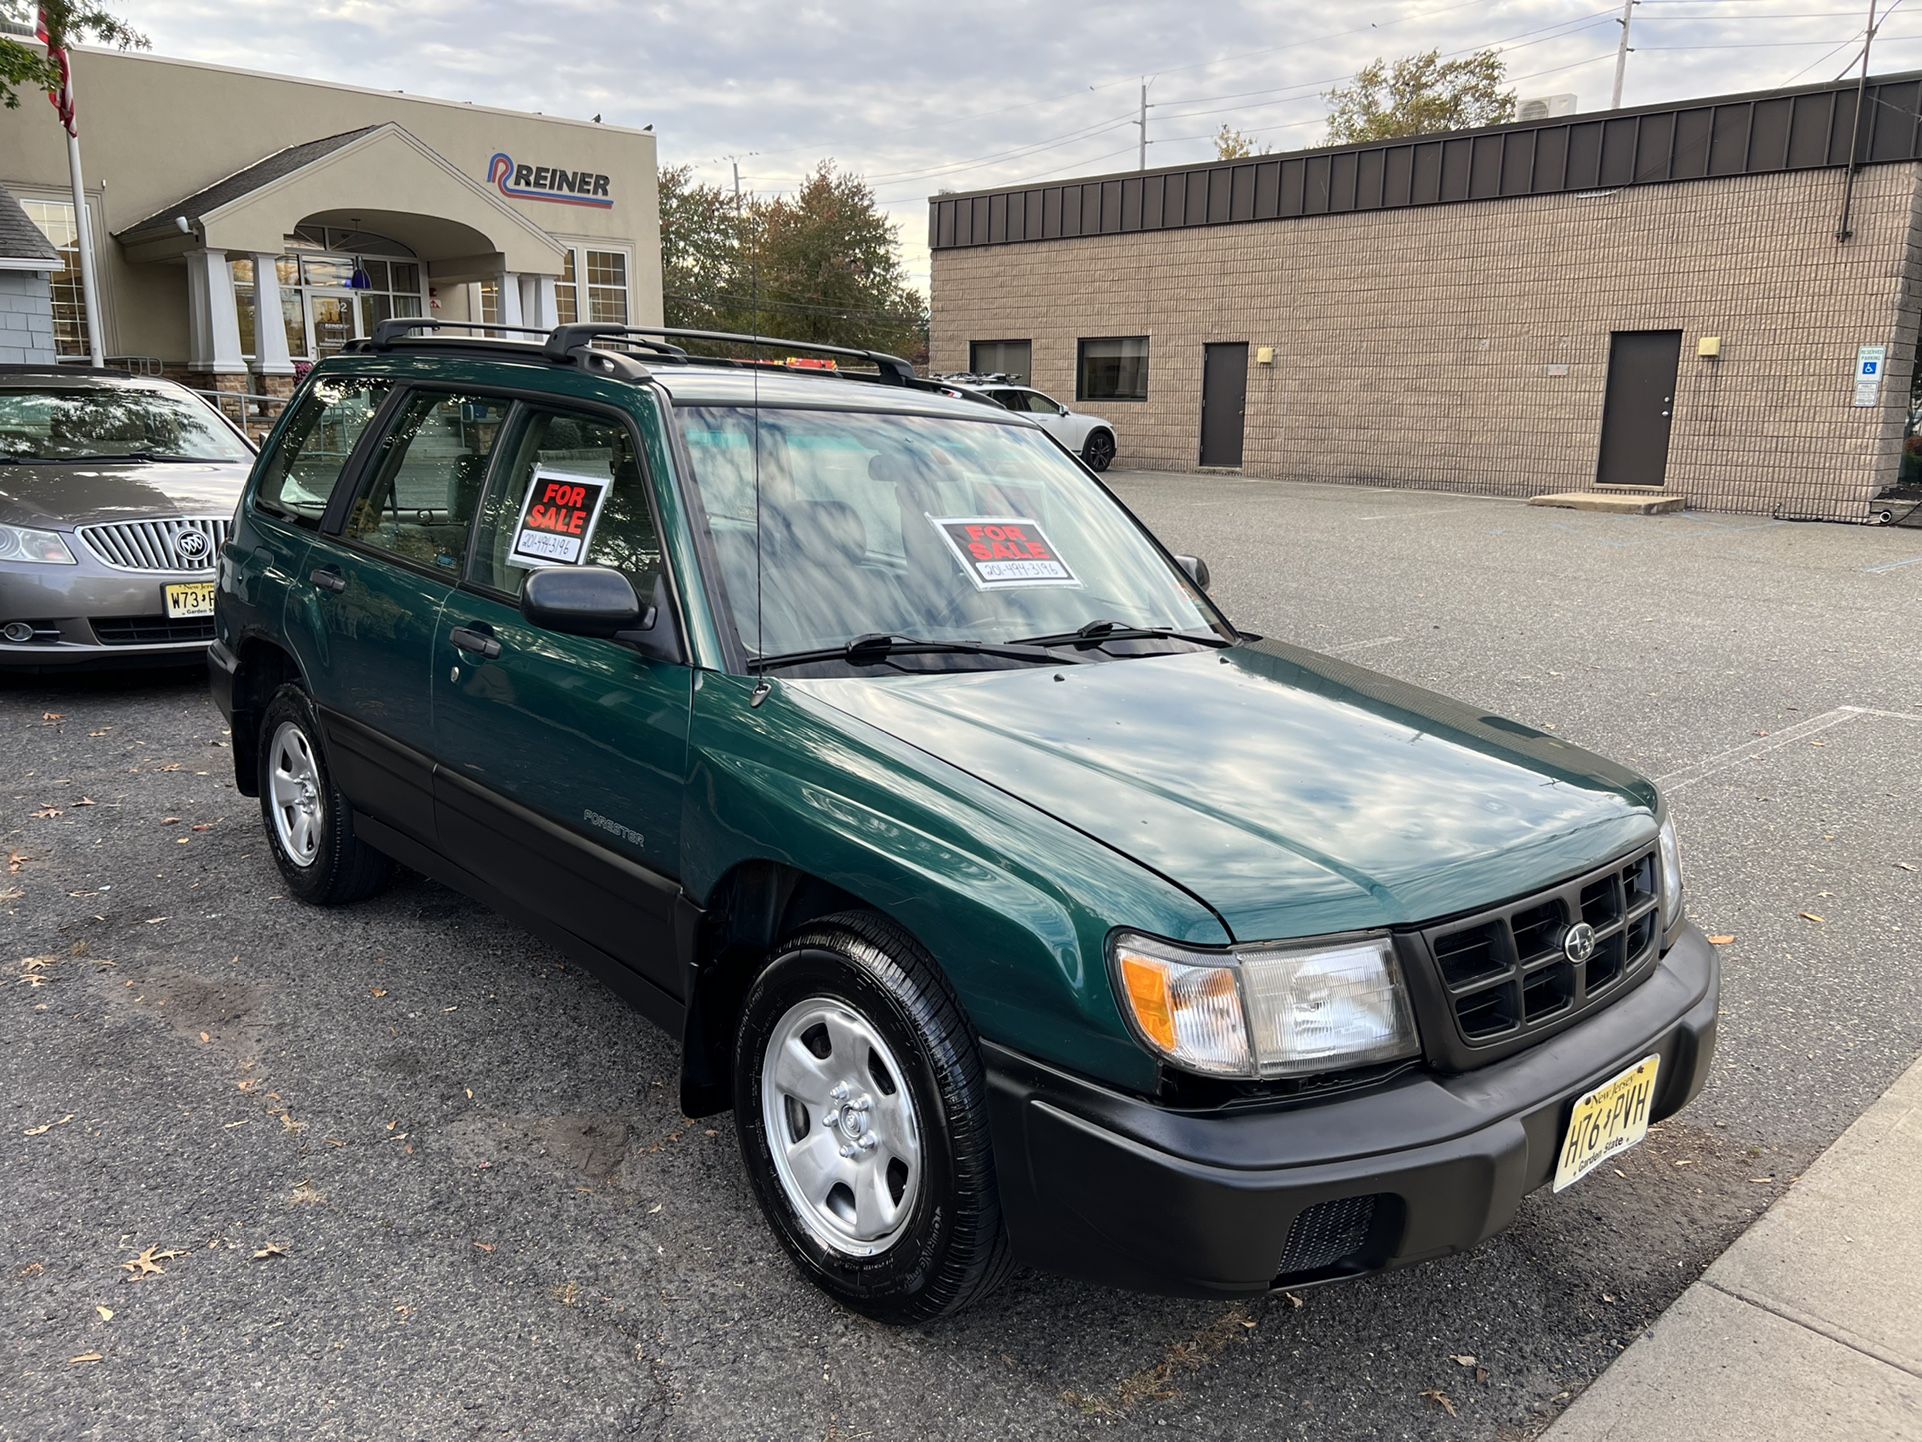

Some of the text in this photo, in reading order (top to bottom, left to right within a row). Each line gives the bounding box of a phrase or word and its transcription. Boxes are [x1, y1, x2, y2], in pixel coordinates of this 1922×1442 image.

[514, 164, 610, 197] REINER
[543, 484, 586, 508] FOR
[528, 505, 587, 535] SALE
[964, 524, 1026, 541] FOR
[968, 542, 1050, 560] SALE
[583, 809, 645, 848] FORESTER
[1590, 1073, 1635, 1108] New Jersey
[1578, 1136, 1624, 1172] Garden State
